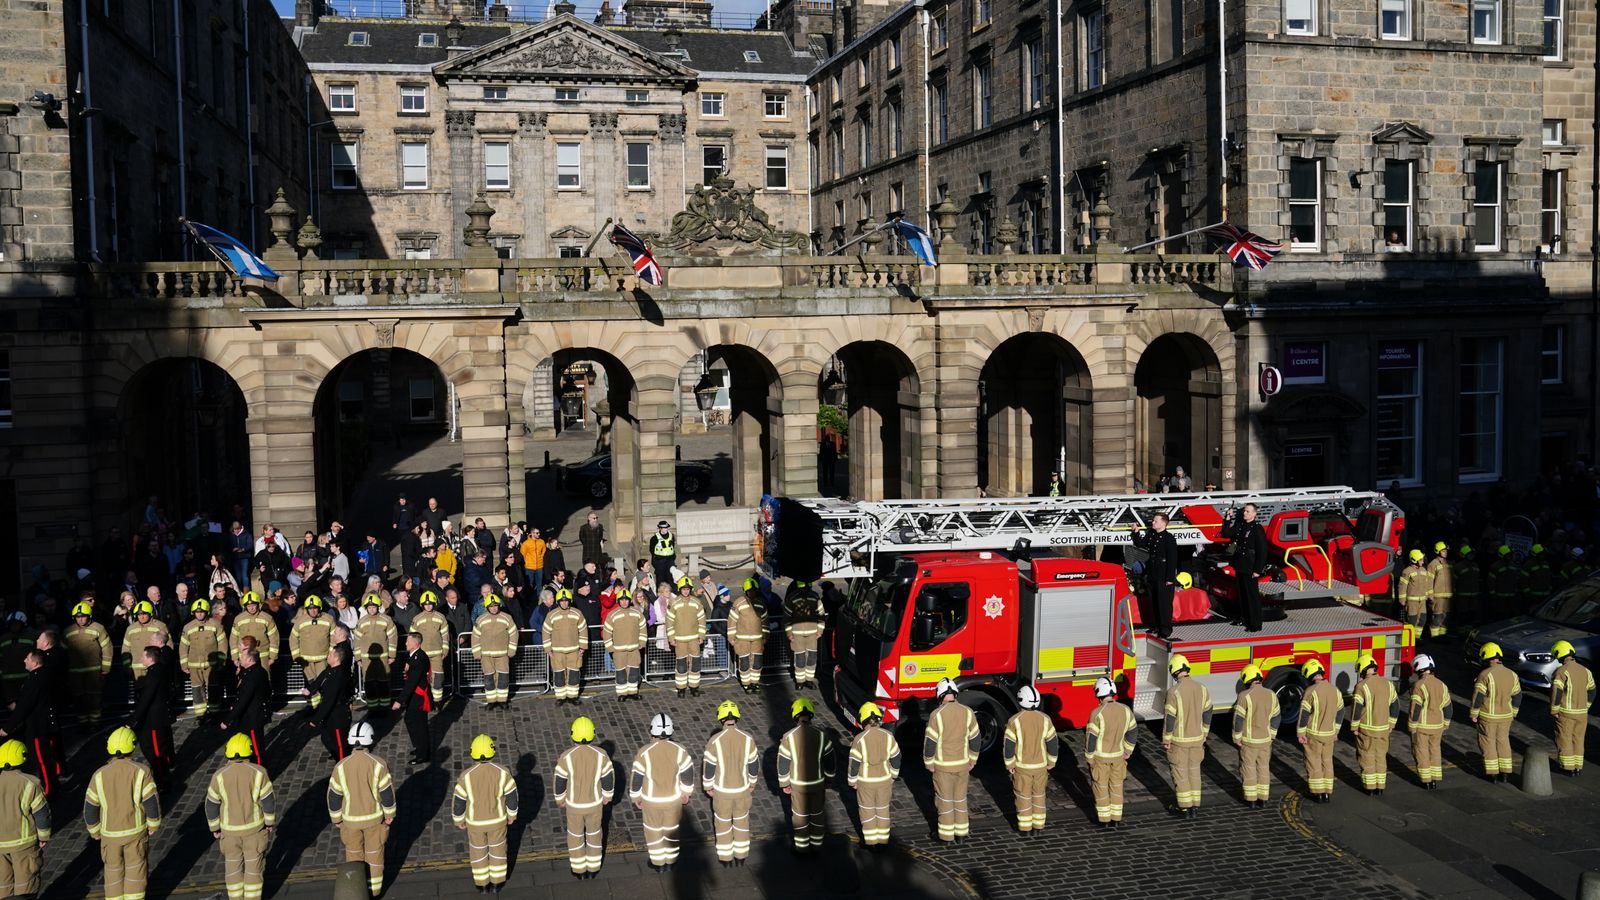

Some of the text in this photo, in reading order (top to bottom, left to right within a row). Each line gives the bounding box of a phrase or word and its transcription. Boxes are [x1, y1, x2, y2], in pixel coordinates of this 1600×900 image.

[1050, 536, 1092, 545] SCOTTISH
[1094, 535, 1112, 543] FIRE
[1113, 534, 1132, 542] AND
[1173, 531, 1201, 540] ERVICE
